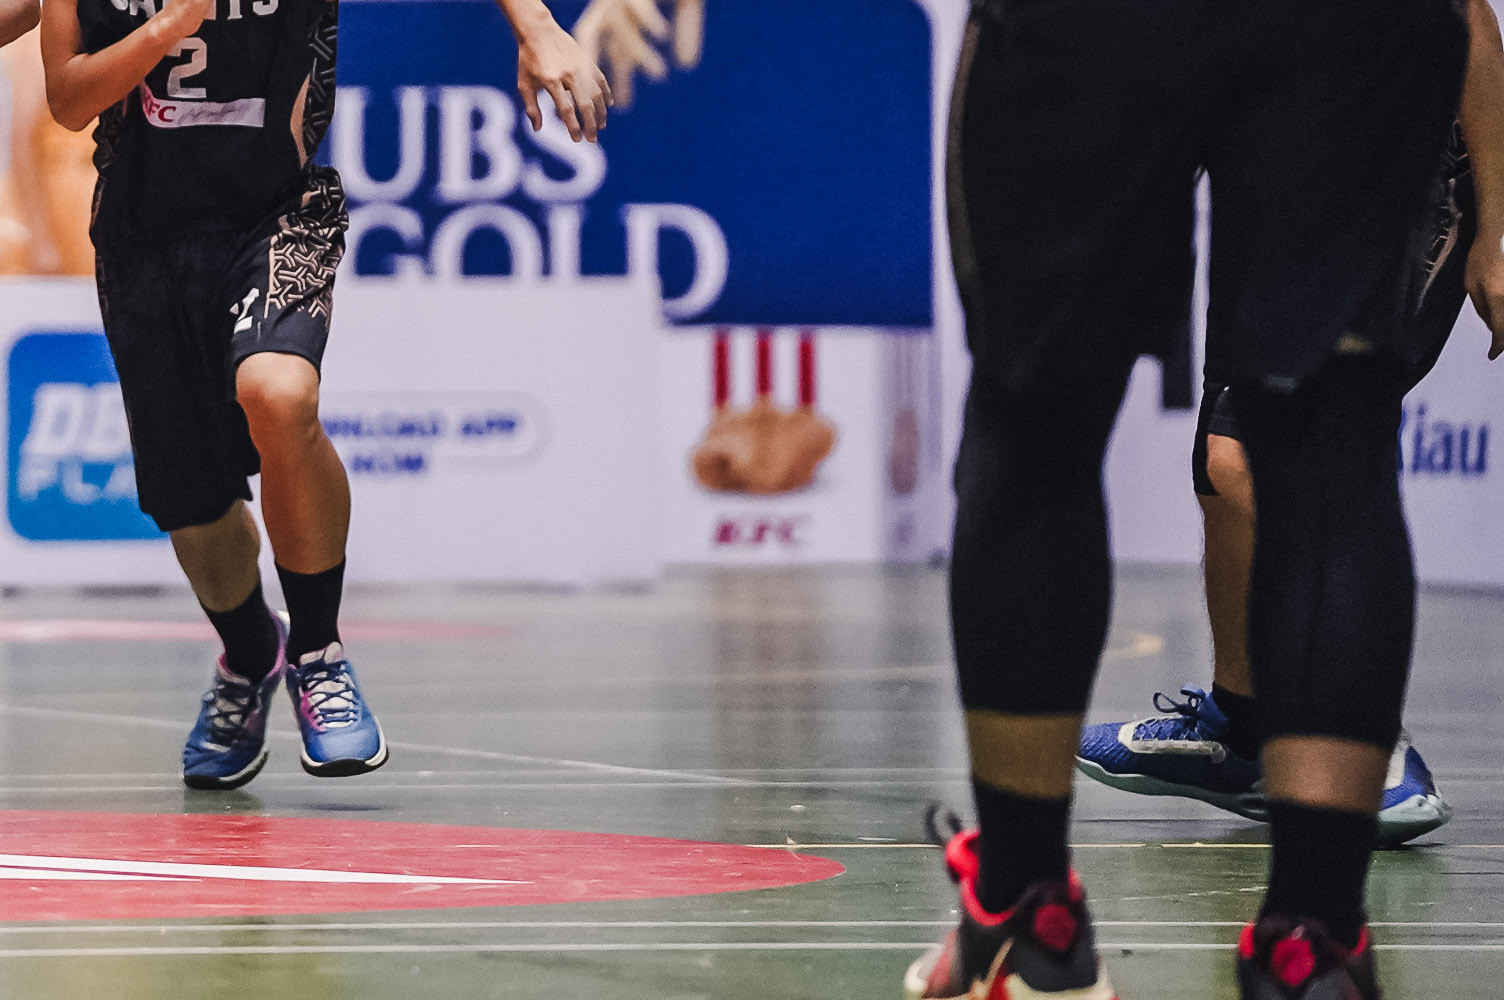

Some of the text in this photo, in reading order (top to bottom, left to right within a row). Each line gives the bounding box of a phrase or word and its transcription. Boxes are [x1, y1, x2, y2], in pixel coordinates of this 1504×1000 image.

[166, 36, 208, 98] 2
[332, 83, 609, 204] UBS
[345, 201, 730, 322] GOLD
[1398, 402, 1489, 475] iau
